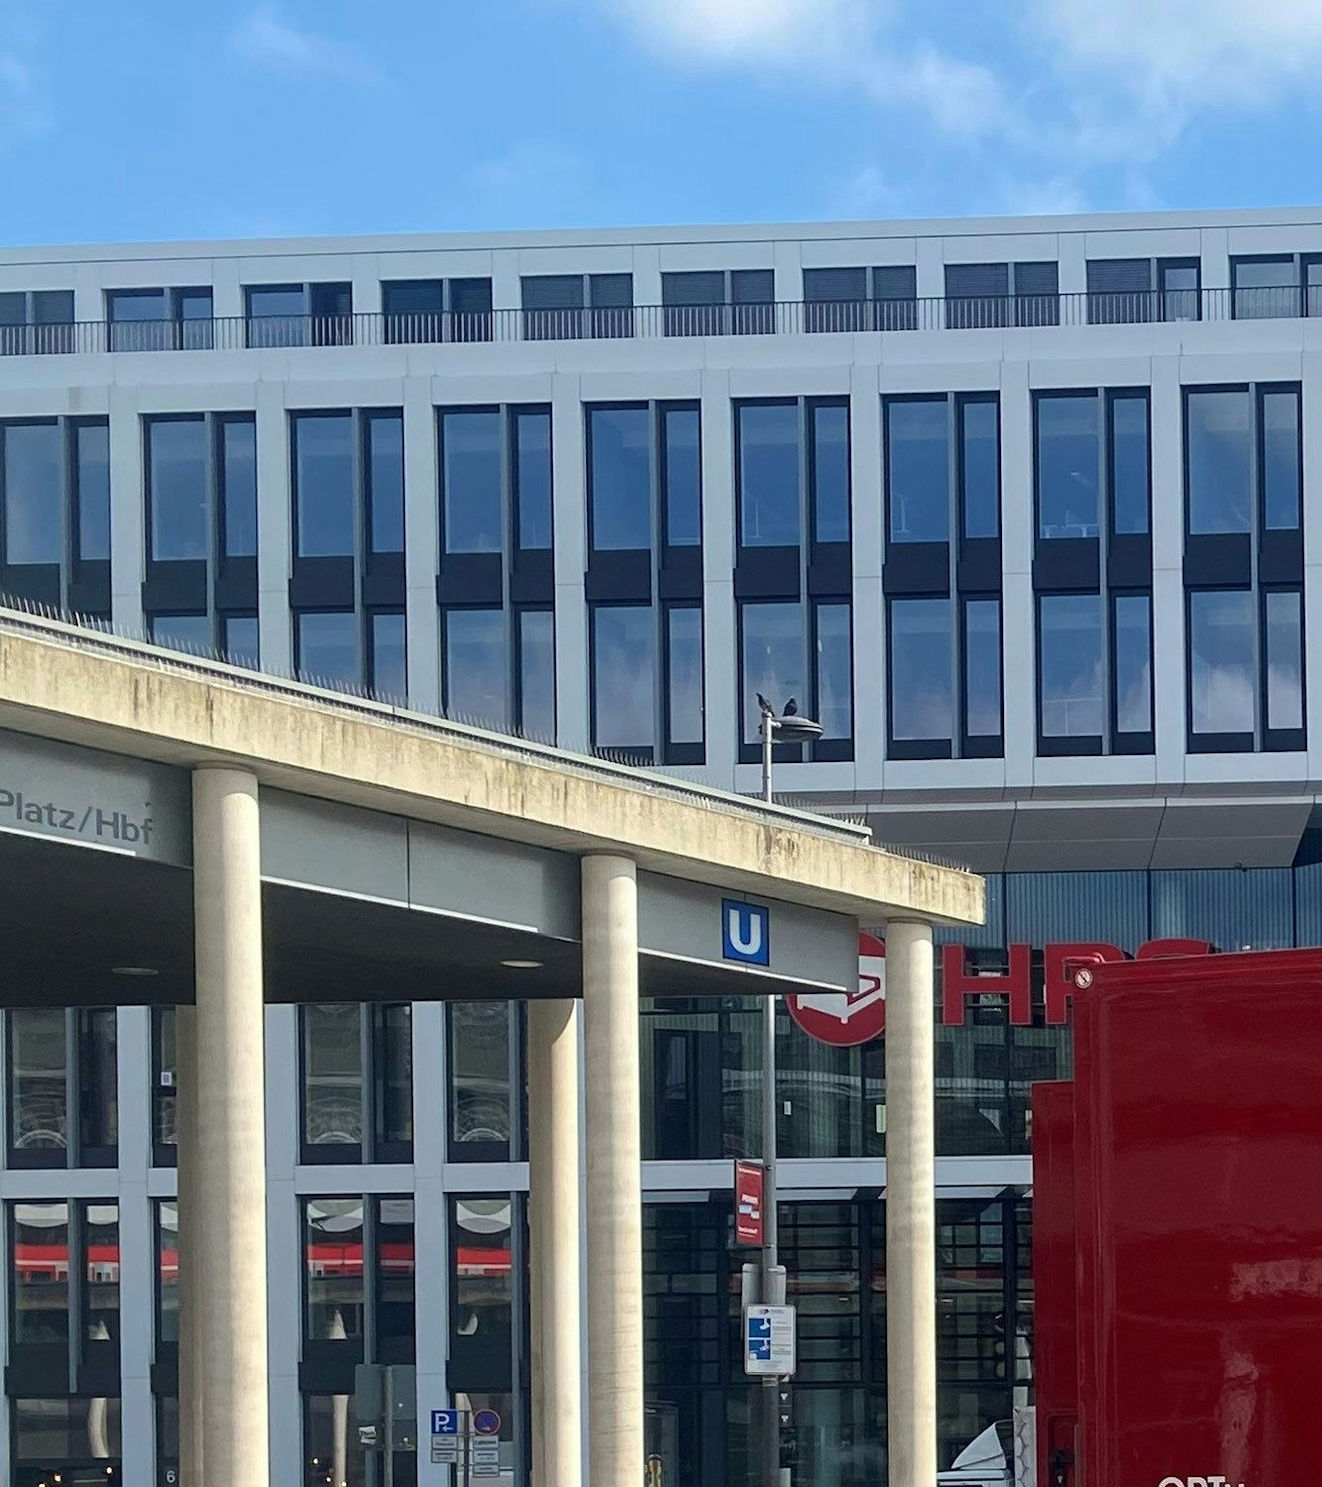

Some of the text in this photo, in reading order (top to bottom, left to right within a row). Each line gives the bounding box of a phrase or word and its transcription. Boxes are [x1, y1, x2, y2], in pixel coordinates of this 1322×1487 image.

[729, 908, 761, 956] U
[434, 1412, 450, 1433] P
[166, 1470, 176, 1483] 6
